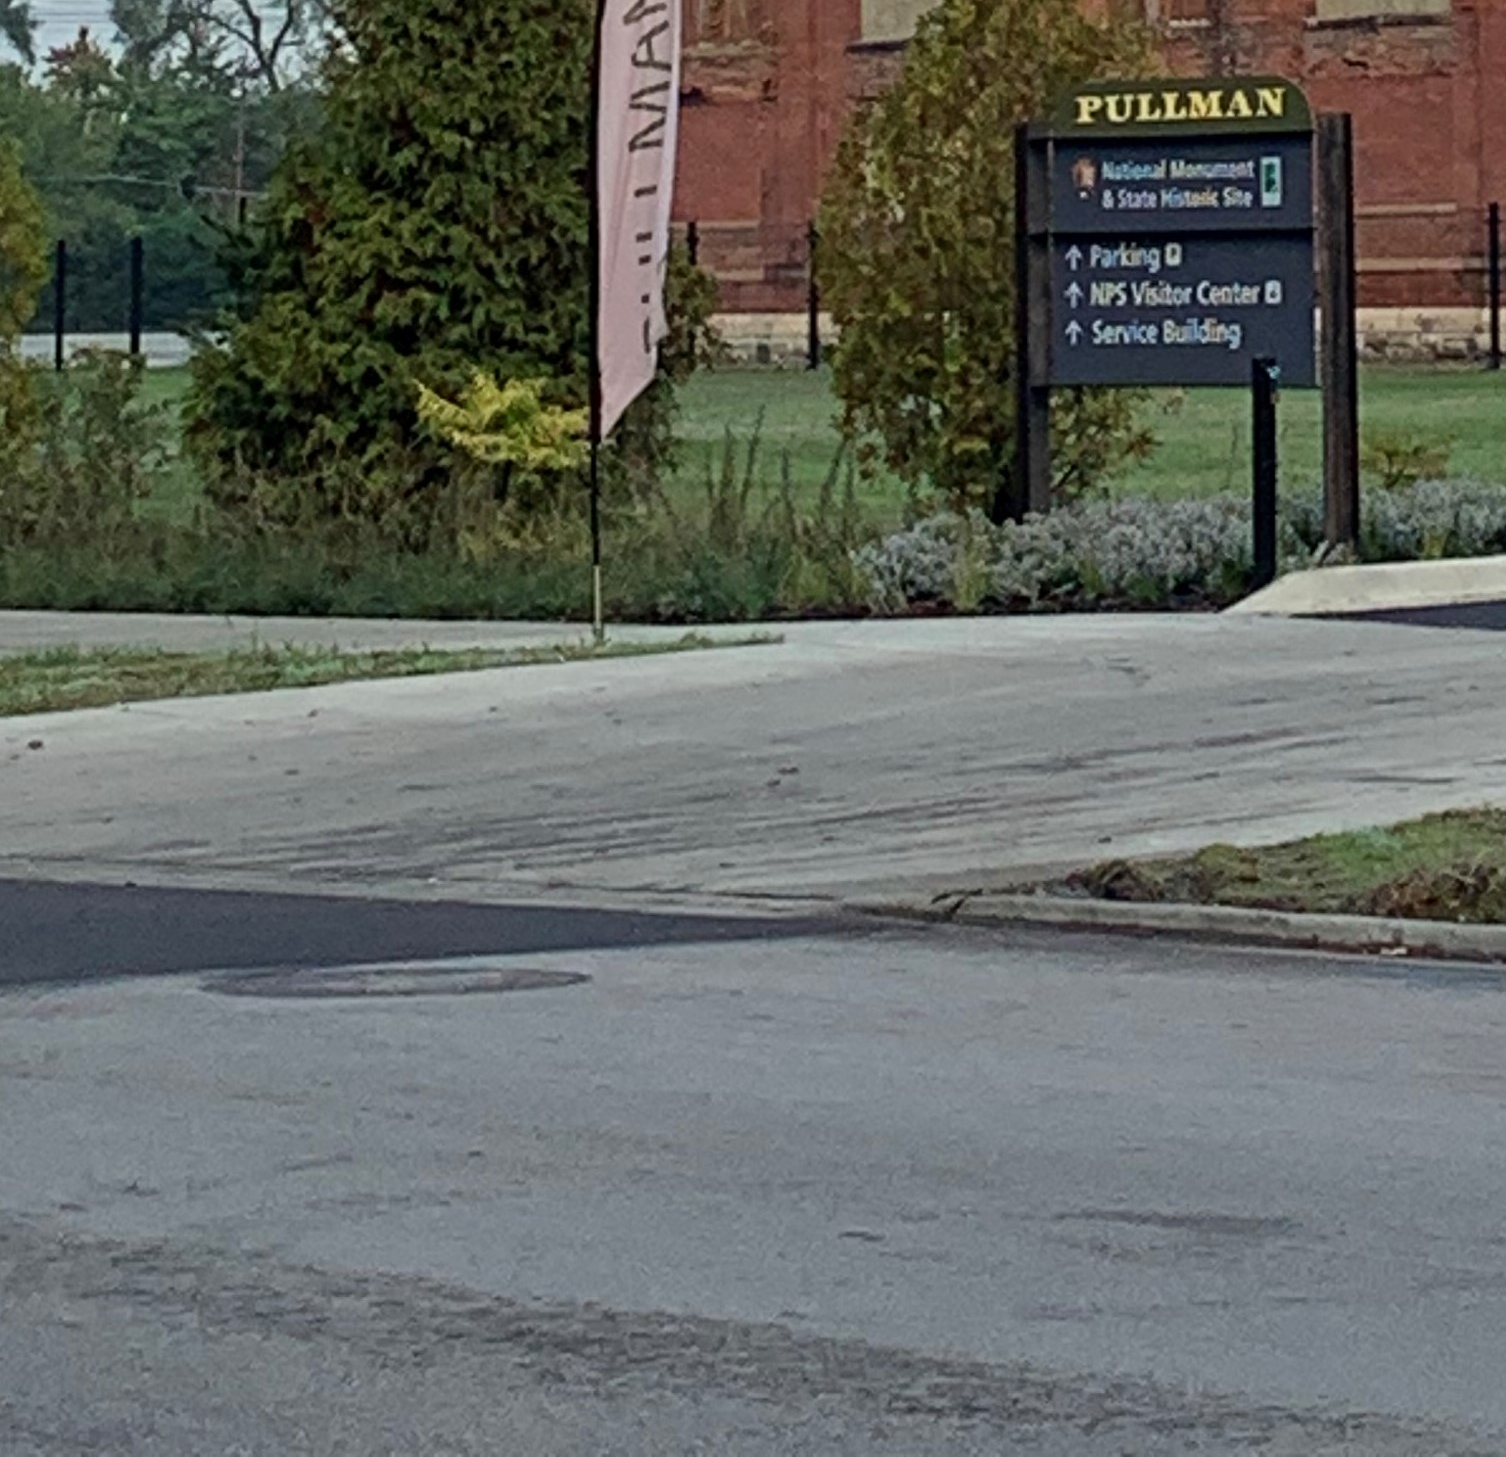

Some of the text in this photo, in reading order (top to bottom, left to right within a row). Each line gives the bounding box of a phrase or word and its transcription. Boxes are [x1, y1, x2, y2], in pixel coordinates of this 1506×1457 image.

[1075, 88, 1286, 123] PULLMAN
[1102, 159, 1256, 181] National Monument
[1101, 187, 1254, 210] & State Historic Site
[1089, 241, 1161, 274] Parking
[1089, 280, 1261, 306] NPS Visitor Center
[1092, 317, 1242, 350] Service Building
